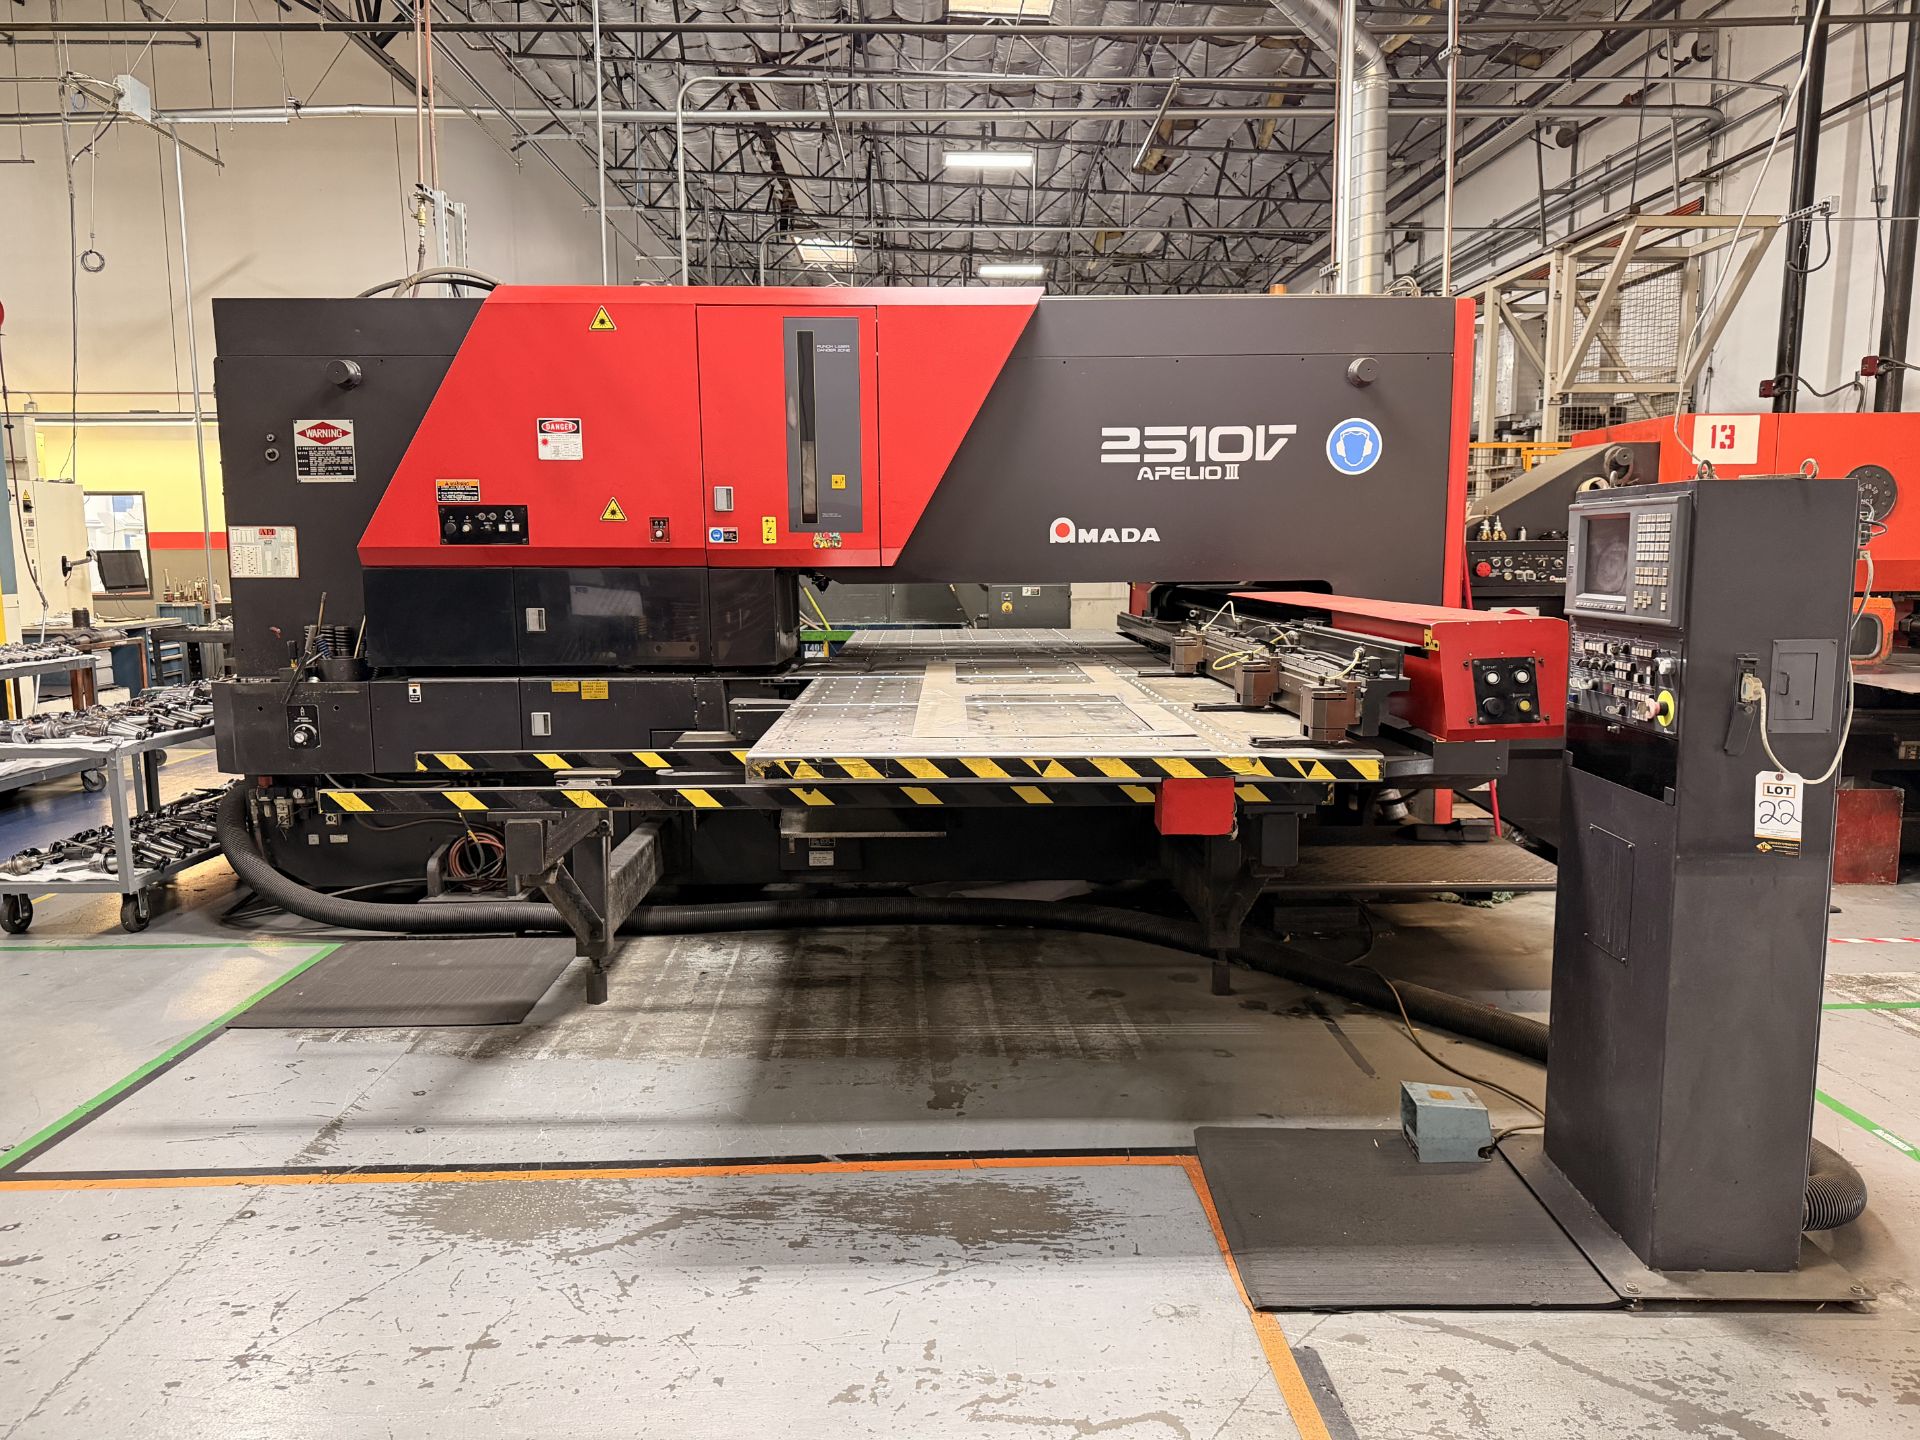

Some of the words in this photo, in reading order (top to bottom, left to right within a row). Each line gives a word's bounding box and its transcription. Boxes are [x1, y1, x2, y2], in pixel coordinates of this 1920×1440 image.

[305, 428, 343, 438] WARNING
[545, 423, 573, 431] DANGER
[1711, 424, 1736, 449] 13
[1137, 466, 1222, 481] APELIO
[1224, 463, 1240, 480] III
[1049, 517, 1161, 544] AMADA
[1766, 785, 1793, 796] LOT
[1759, 799, 1803, 826] 22
